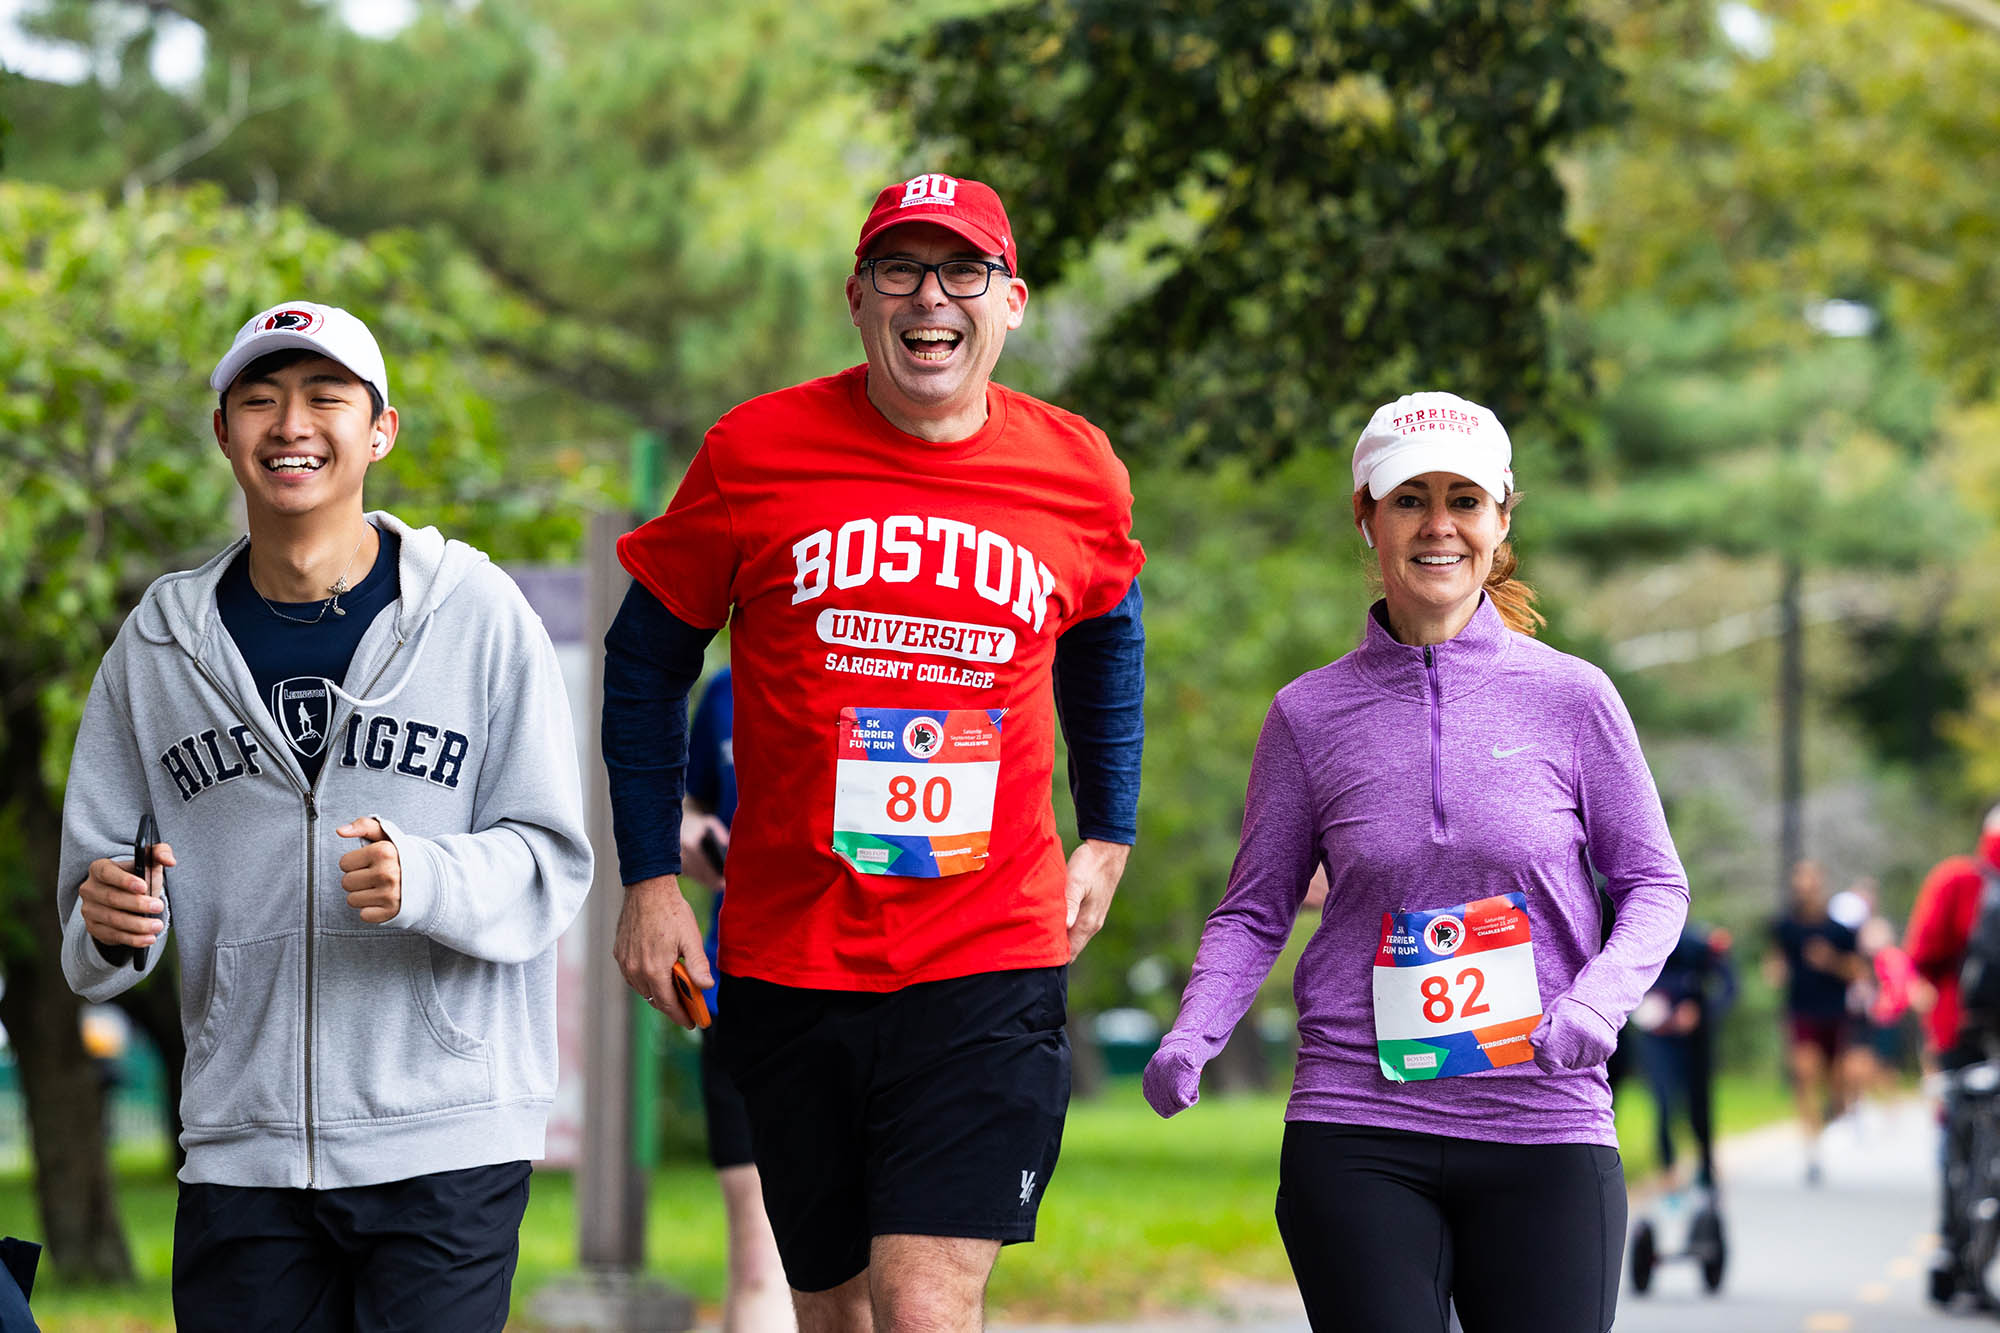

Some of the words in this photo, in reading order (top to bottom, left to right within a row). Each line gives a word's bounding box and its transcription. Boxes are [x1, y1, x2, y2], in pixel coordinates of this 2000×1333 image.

[902, 174, 959, 202] BU
[1393, 408, 1479, 427] TERRIERS
[1402, 422, 1472, 436] LACROSSE
[791, 515, 1056, 634] BOSTON
[831, 614, 1005, 657] UNIVERSITY
[825, 653, 913, 680] SARGENT
[916, 664, 995, 689] COLLEGE
[284, 688, 326, 700] LEXINGTON
[866, 719, 881, 728] 5K
[851, 729, 895, 740] TERRIER
[849, 739, 871, 749] FUN
[873, 740, 895, 750] RUN
[886, 775, 952, 823] 80
[1484, 915, 1506, 923] Saturday
[1472, 922, 1499, 932] September
[1477, 928, 1500, 937] CHARLES
[1501, 925, 1516, 933] RIVER
[1386, 935, 1416, 945] TERRIER
[1382, 945, 1397, 955] FUN
[1398, 945, 1419, 955] RUN
[1420, 967, 1490, 1023] 82
[1476, 1034, 1527, 1050] #TERRIERPRIDE
